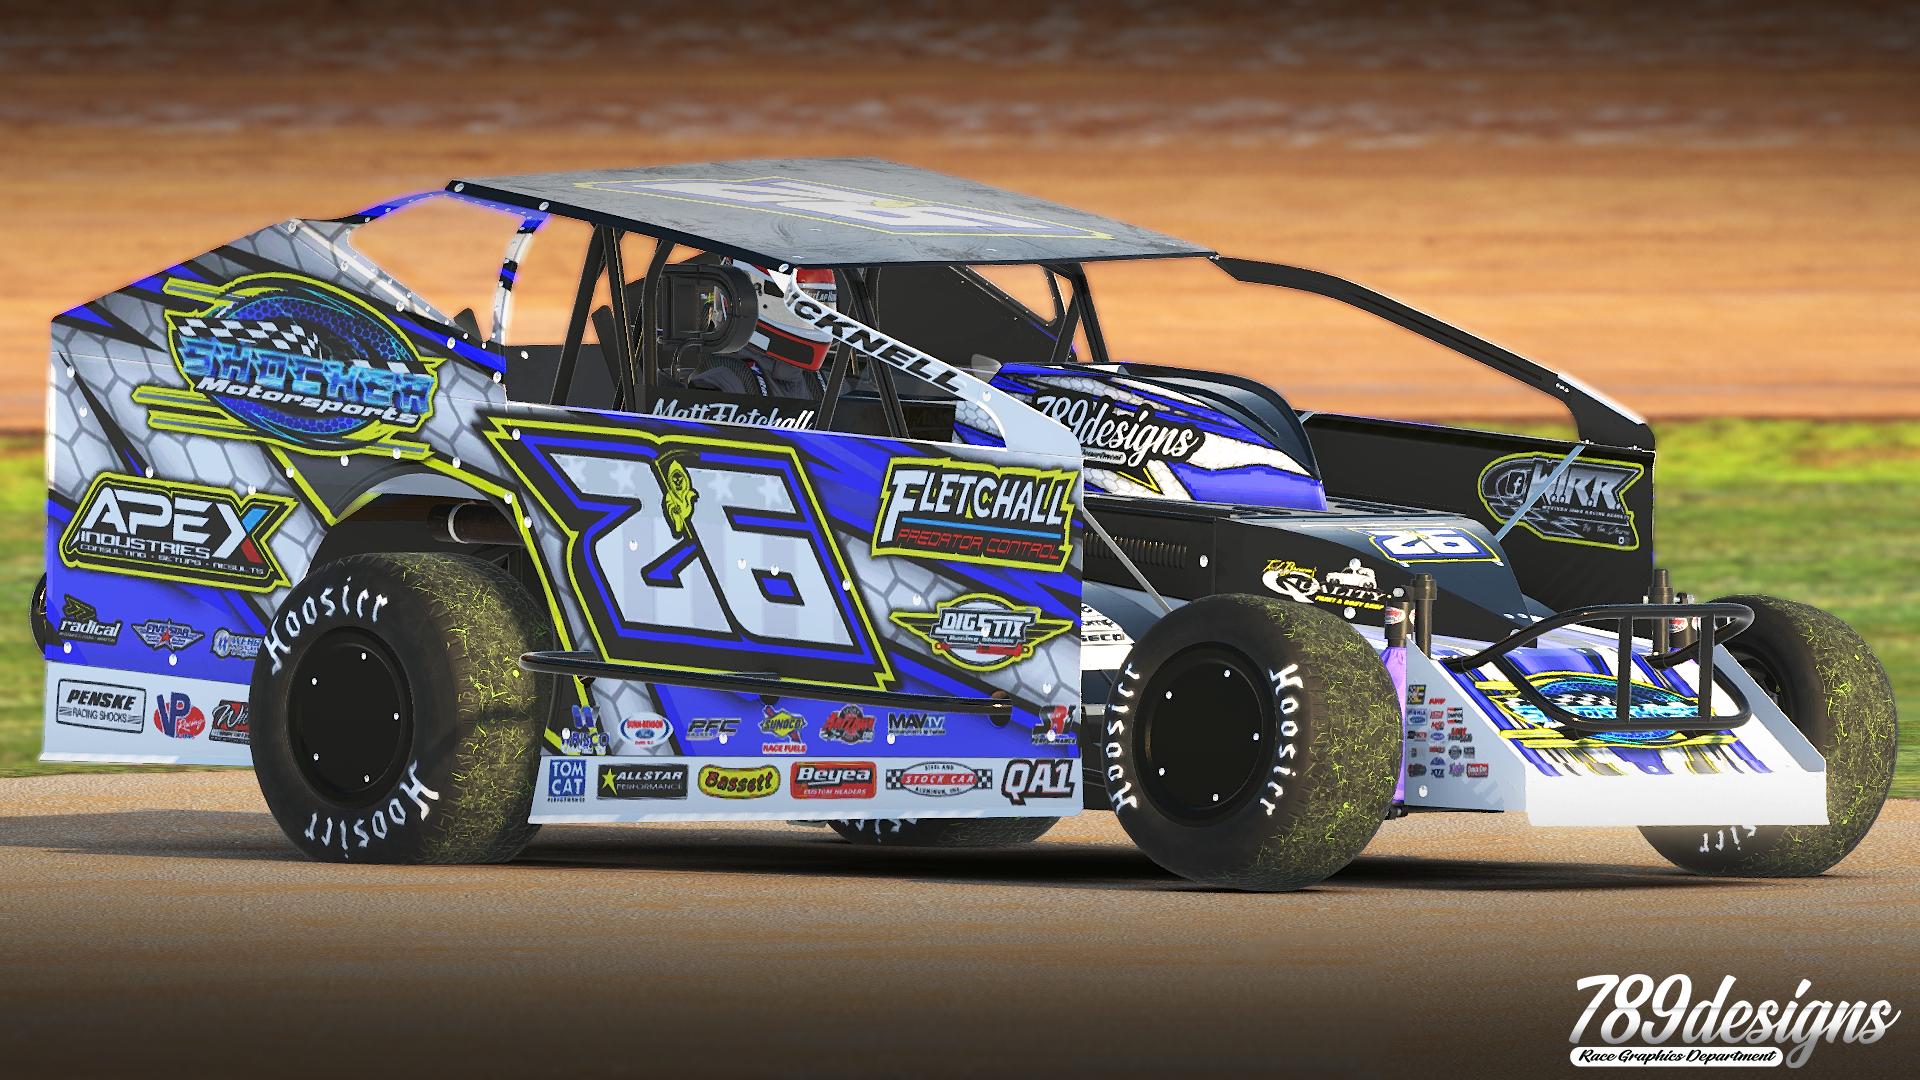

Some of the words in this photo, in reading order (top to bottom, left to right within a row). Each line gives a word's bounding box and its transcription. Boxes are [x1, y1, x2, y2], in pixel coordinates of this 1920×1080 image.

[179, 337, 435, 413] SHOCKER
[196, 377, 421, 426] Motorsports
[881, 470, 1064, 543] FLETCHALL
[80, 487, 269, 564] APEX
[80, 529, 211, 559] INDUSTRIES
[550, 452, 853, 647] 26
[896, 529, 984, 552] PREDATOR
[986, 538, 1060, 560] CONTROL
[1362, 529, 1482, 555] 26
[60, 620, 121, 637] radical
[67, 689, 136, 711] PENSKE
[72, 707, 98, 720] RACING
[99, 711, 127, 723] SHOCKS
[157, 692, 191, 739] VP
[688, 718, 741, 733] PFC
[763, 718, 804, 731] SUNOCO
[552, 761, 583, 777] TOM
[616, 771, 683, 781] ALLSTAR
[797, 766, 871, 786] Beyea
[905, 775, 942, 784] STOCK
[949, 775, 974, 784] CAR
[552, 779, 583, 796] CAT
[616, 782, 683, 791] PERFORMANCE
[705, 769, 774, 793] Bassett
[1001, 759, 1075, 806] QA1
